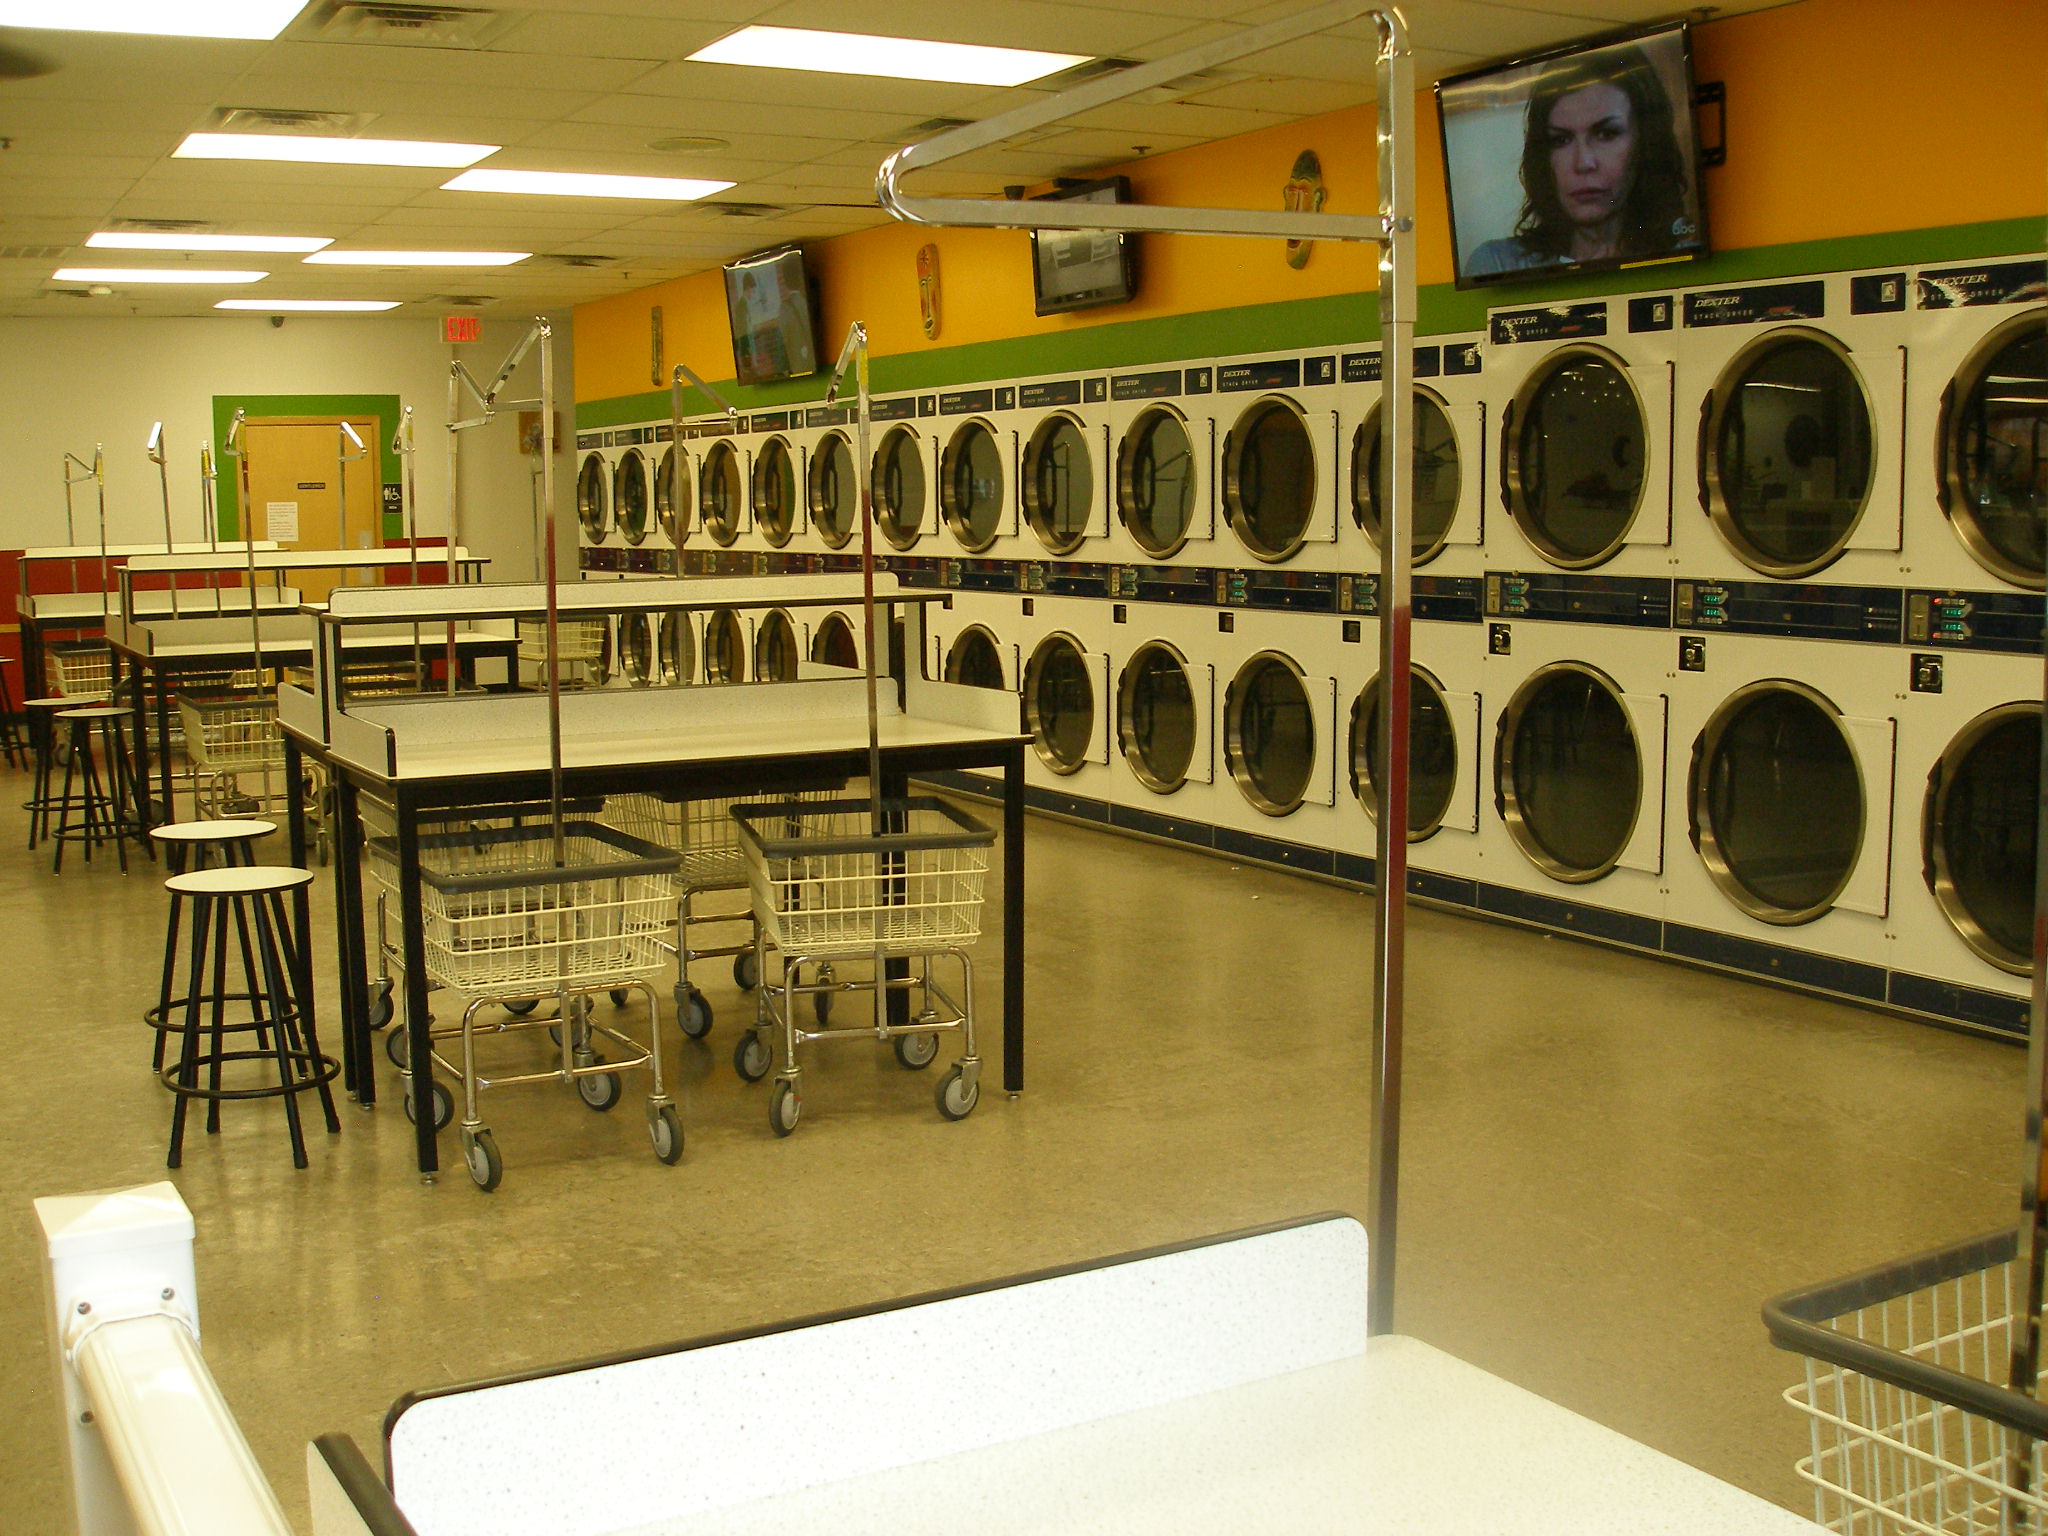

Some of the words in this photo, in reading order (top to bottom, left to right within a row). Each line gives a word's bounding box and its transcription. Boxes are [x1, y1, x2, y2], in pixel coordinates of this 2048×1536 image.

[1672, 218, 1696, 235] abc
[1933, 274, 1987, 286] DEXTER
[1694, 296, 1740, 308] DEXTER
[1499, 316, 1538, 327] DEXTER
[447, 317, 477, 340] EXIT
[1348, 357, 1381, 367] DEXTER
[1223, 369, 1250, 378] DEXTER
[1116, 379, 1140, 387] DEXTER
